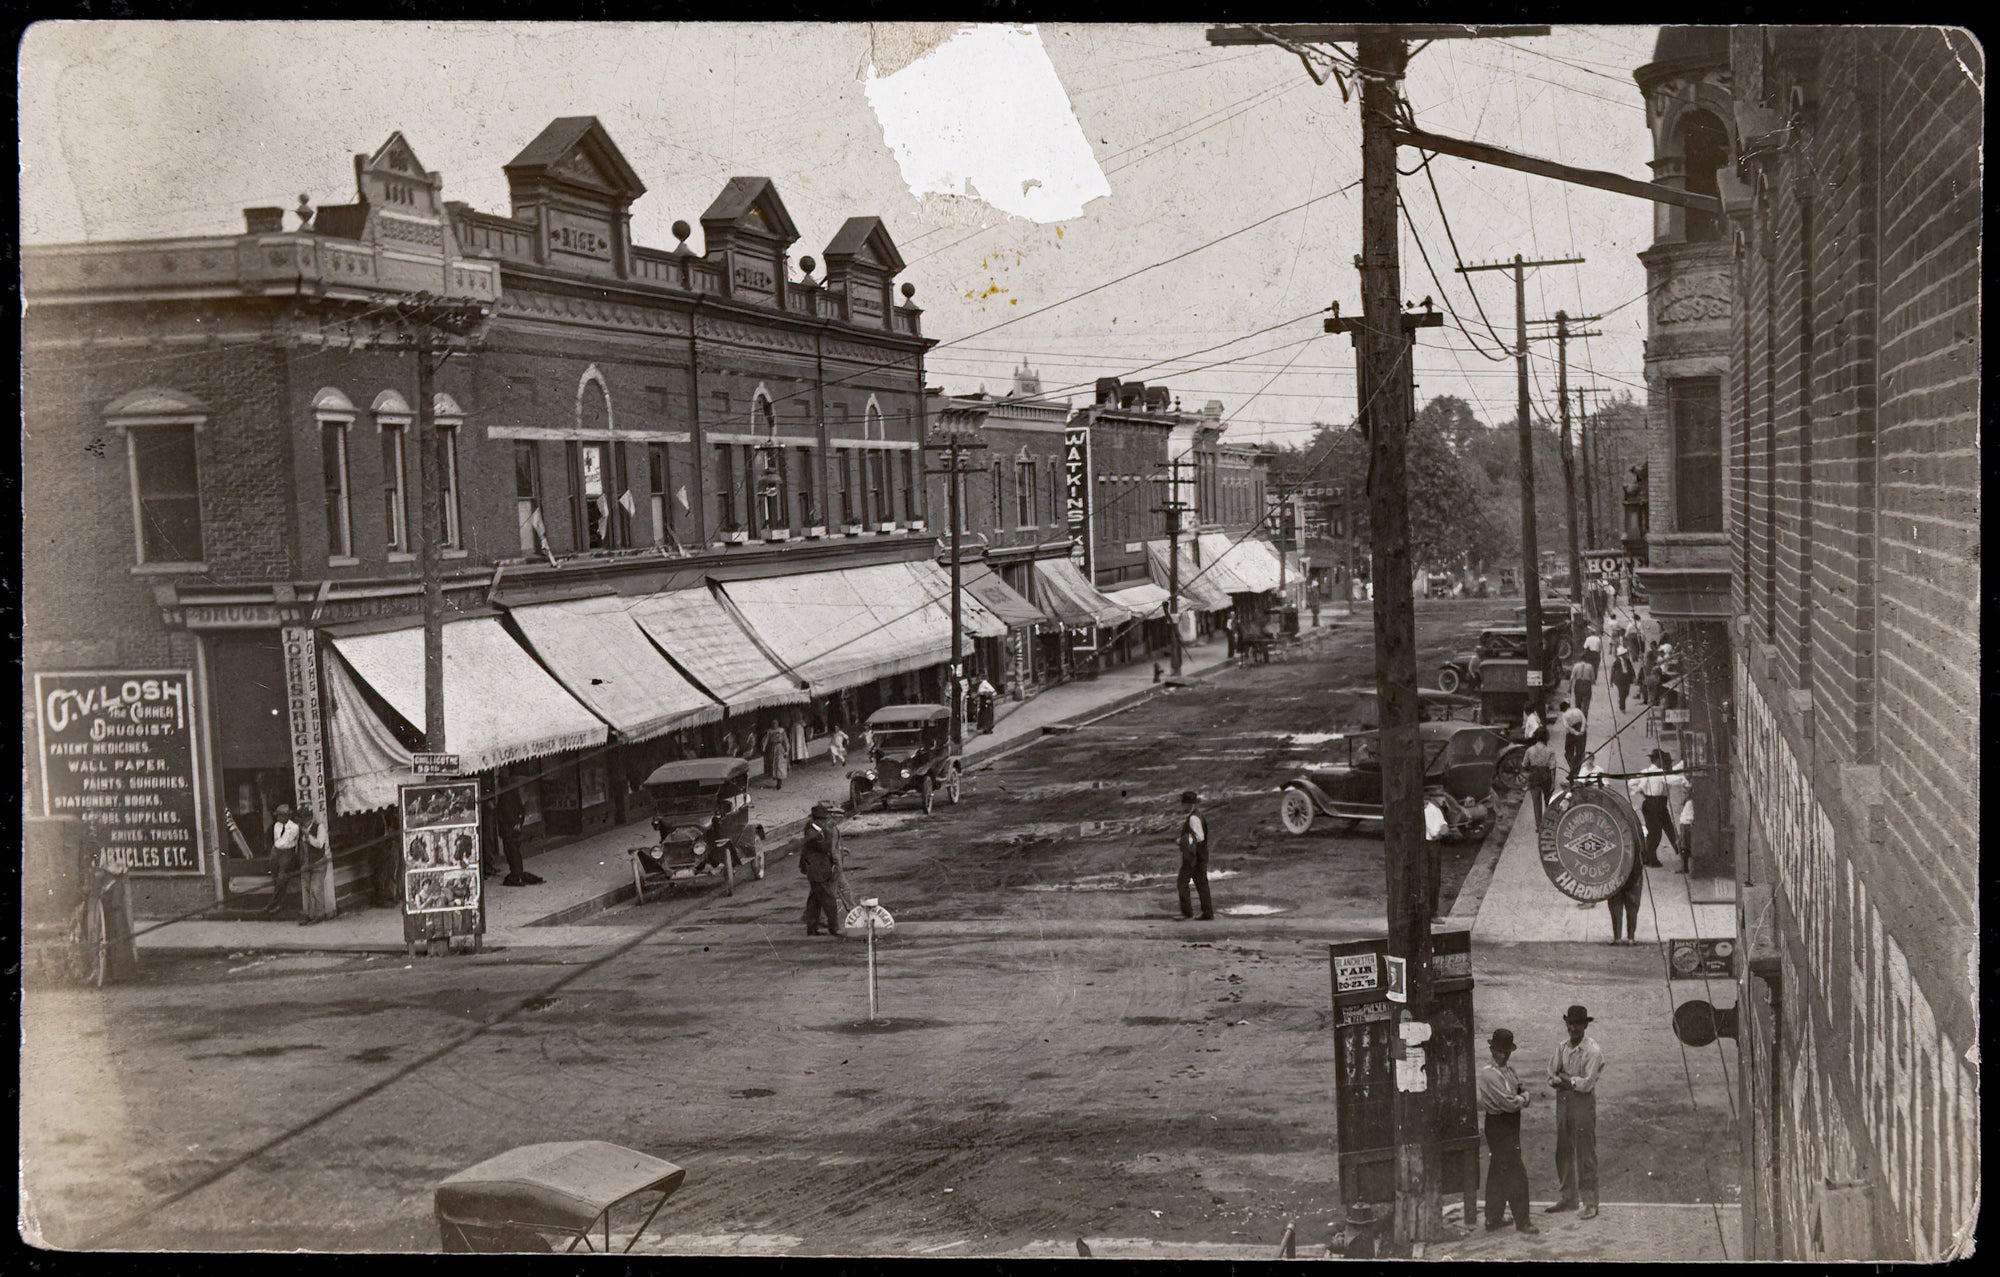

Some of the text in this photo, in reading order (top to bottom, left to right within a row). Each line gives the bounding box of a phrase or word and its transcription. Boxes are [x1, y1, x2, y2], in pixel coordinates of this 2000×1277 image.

[101, 680, 184, 729] LOSH
[68, 760, 107, 773] WALL
[1575, 858, 1612, 878] TOOLS
[1340, 966, 1372, 976] FAIR
